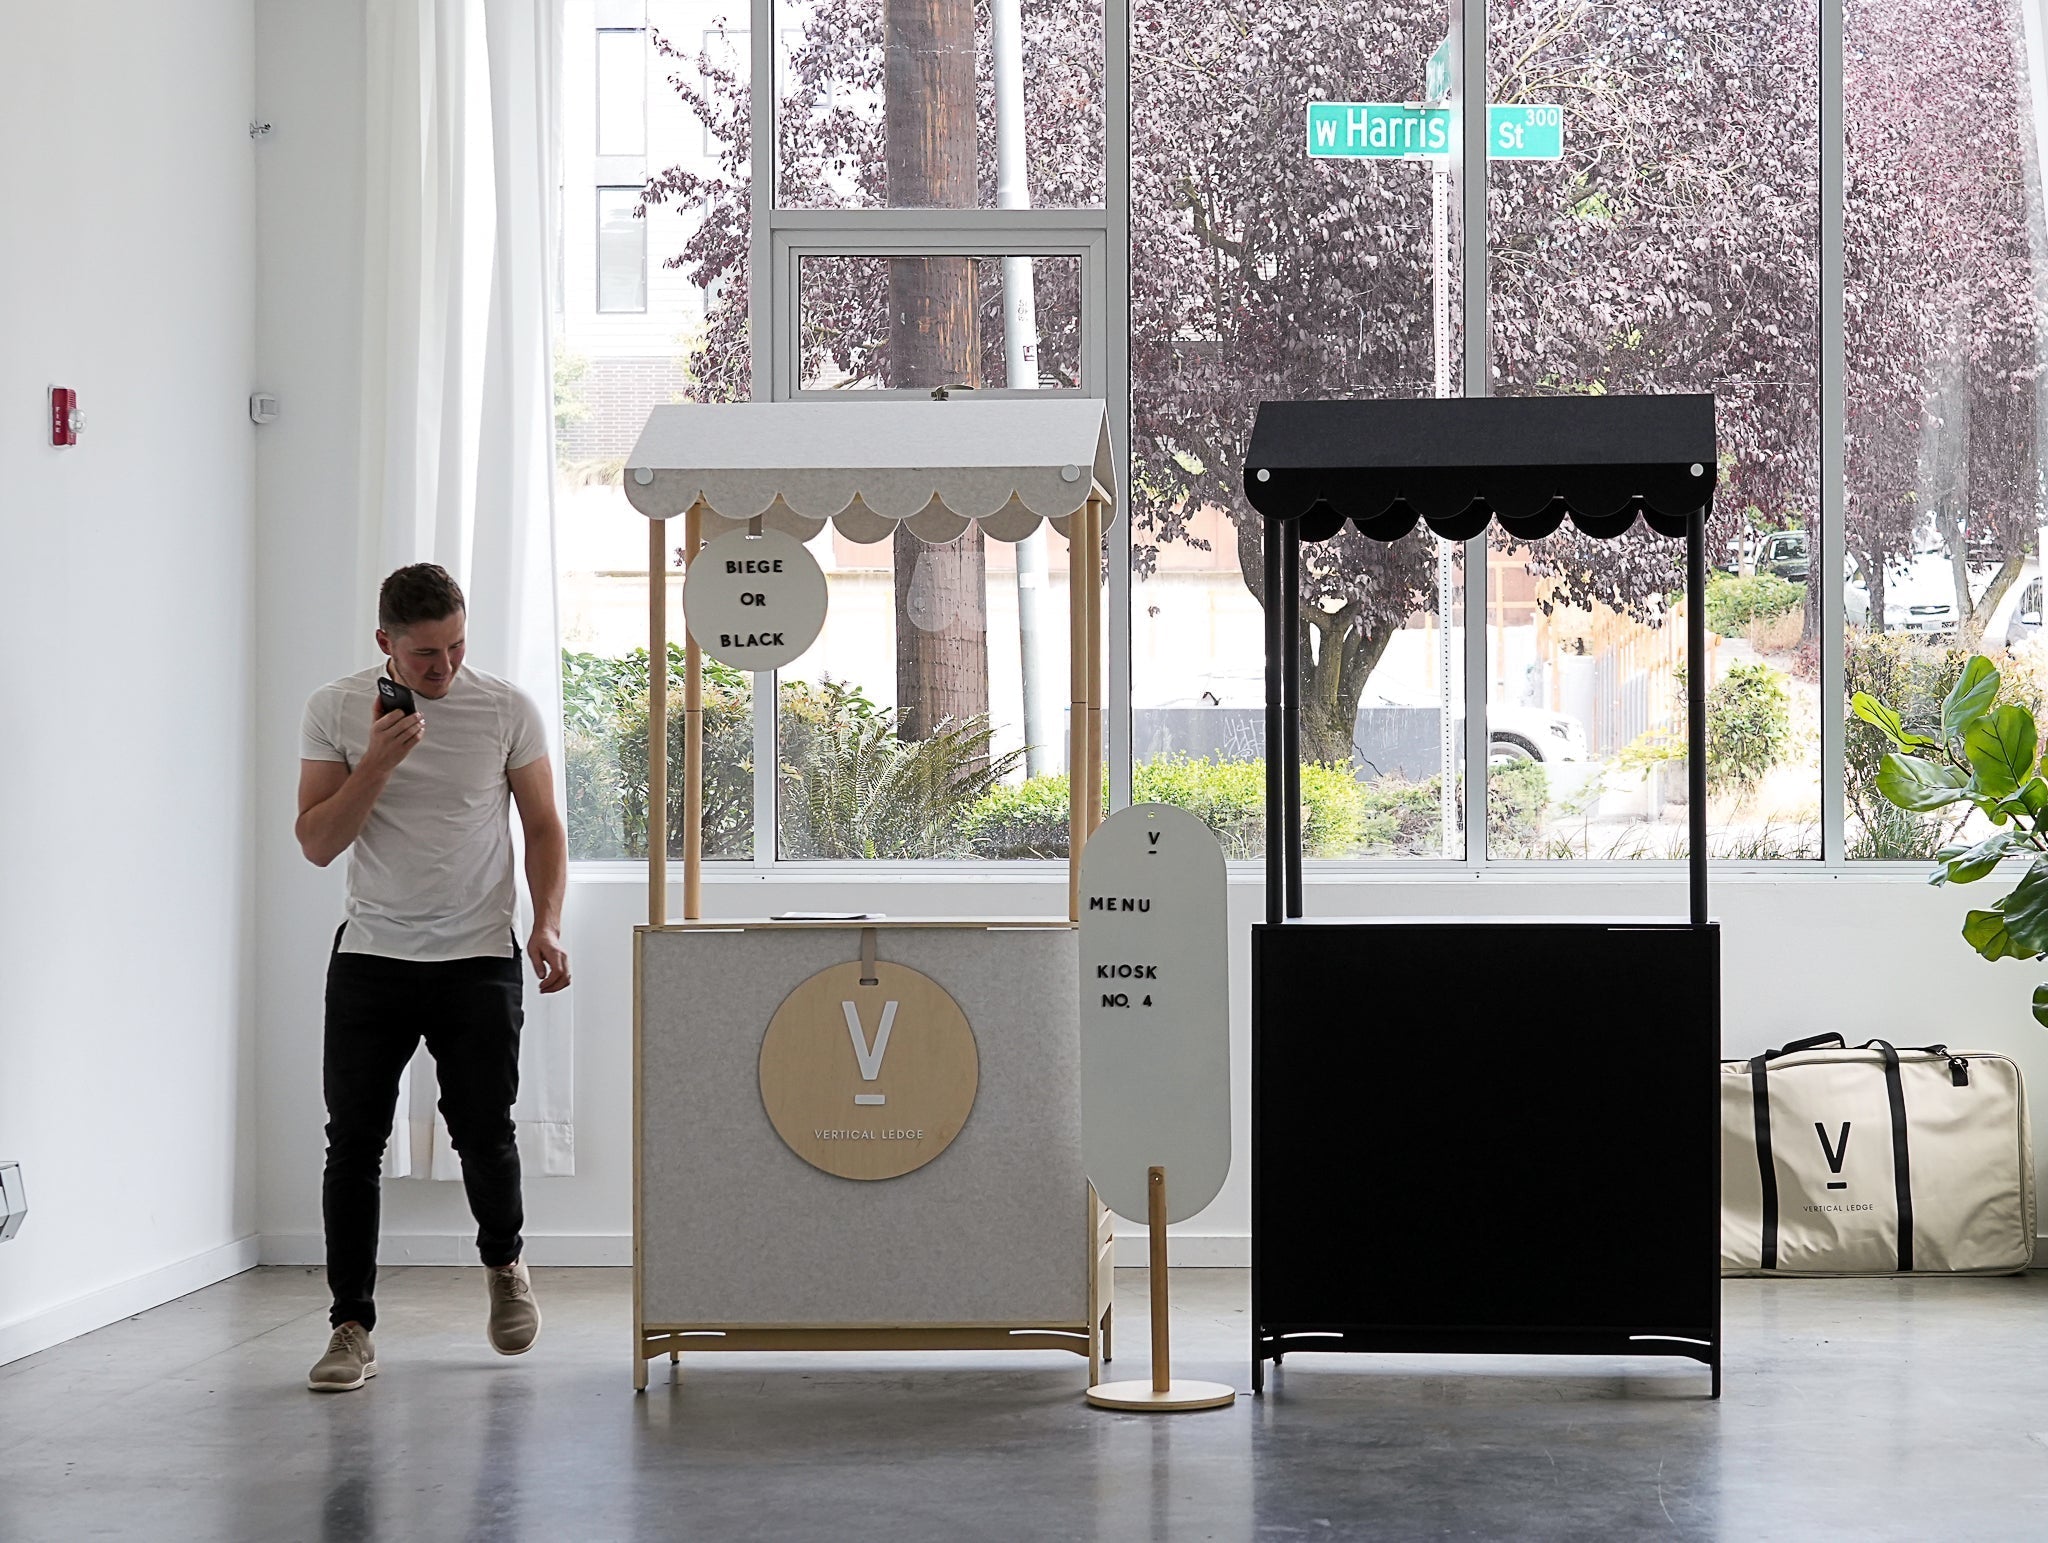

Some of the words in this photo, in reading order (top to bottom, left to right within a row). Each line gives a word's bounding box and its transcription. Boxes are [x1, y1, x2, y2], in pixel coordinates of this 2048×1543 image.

[1525, 109, 1558, 127] 300
[1346, 108, 1446, 149] Harris
[1498, 121, 1524, 149] St
[726, 560, 783, 574] BIEGE
[740, 592, 766, 607] OR
[720, 632, 784, 648] BLACK
[1089, 896, 1151, 913] MENU
[1097, 964, 1158, 980] KIOSK
[1102, 993, 1130, 1009] NO.
[1142, 994, 1153, 1008] 4
[841, 1000, 899, 1081] V
[814, 1129, 876, 1140] VERTICAL
[882, 1129, 924, 1140] LEDGE
[1814, 1121, 1851, 1174] V
[1803, 1205, 1843, 1213] VERTICAL
[1846, 1203, 1874, 1212] LEDGE
